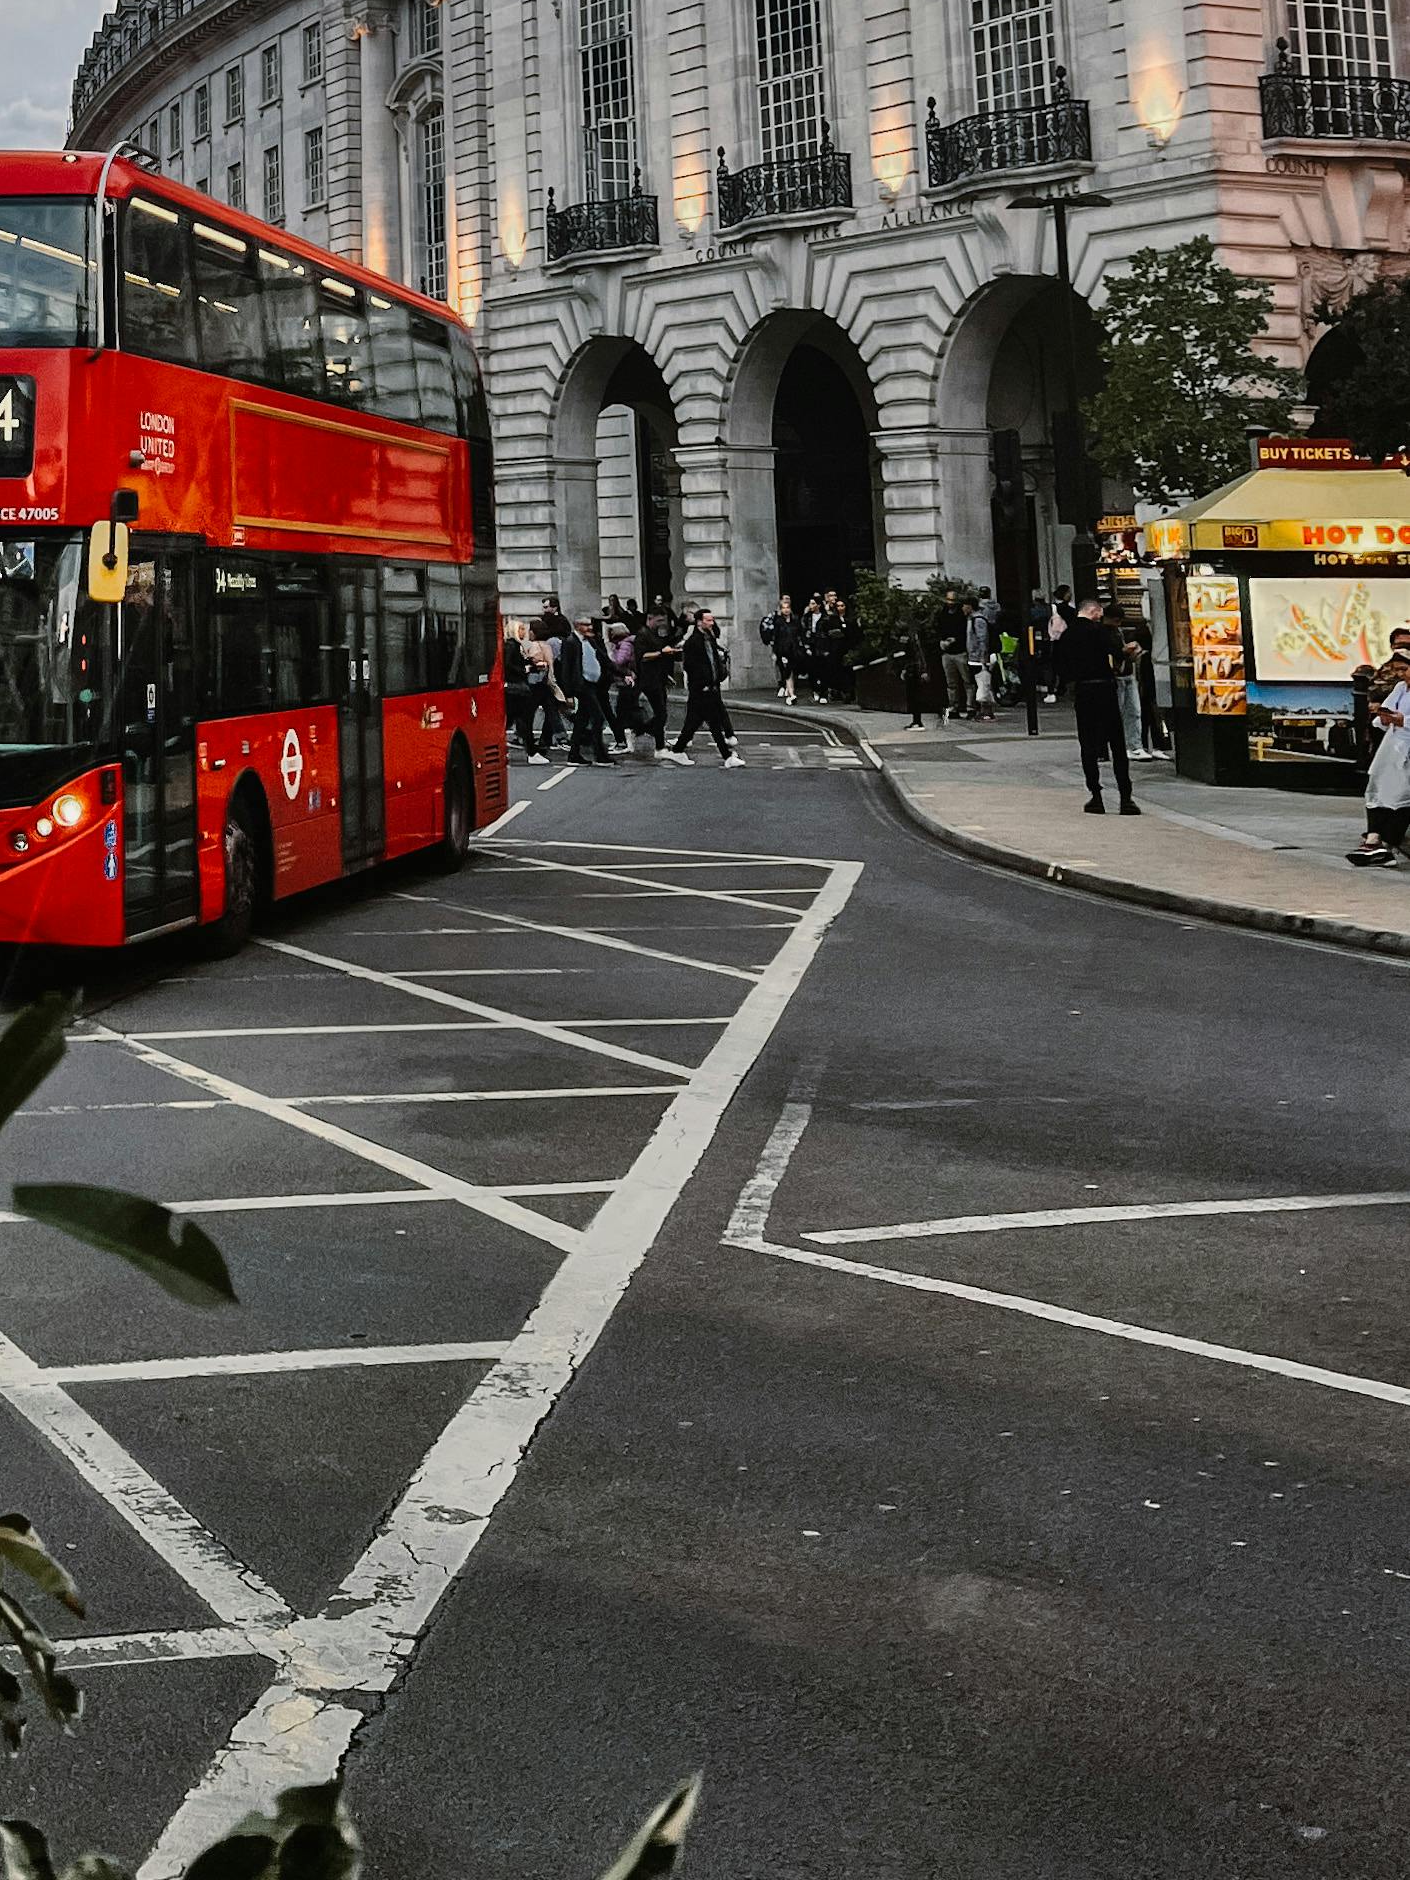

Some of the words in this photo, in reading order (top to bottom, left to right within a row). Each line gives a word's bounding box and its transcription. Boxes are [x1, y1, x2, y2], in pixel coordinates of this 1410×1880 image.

[1265, 157, 1330, 176] COUNTY
[695, 242, 753, 263] COUNT
[880, 200, 975, 230] ALLIANC
[140, 410, 175, 435] LONDON
[140, 434, 175, 458] UNITED
[1259, 447, 1289, 460] BUY
[1290, 447, 1352, 460] TICKETS
[18, 507, 59, 521] 47005
[1302, 525, 1364, 545] HOT
[1313, 552, 1349, 566] HOT
